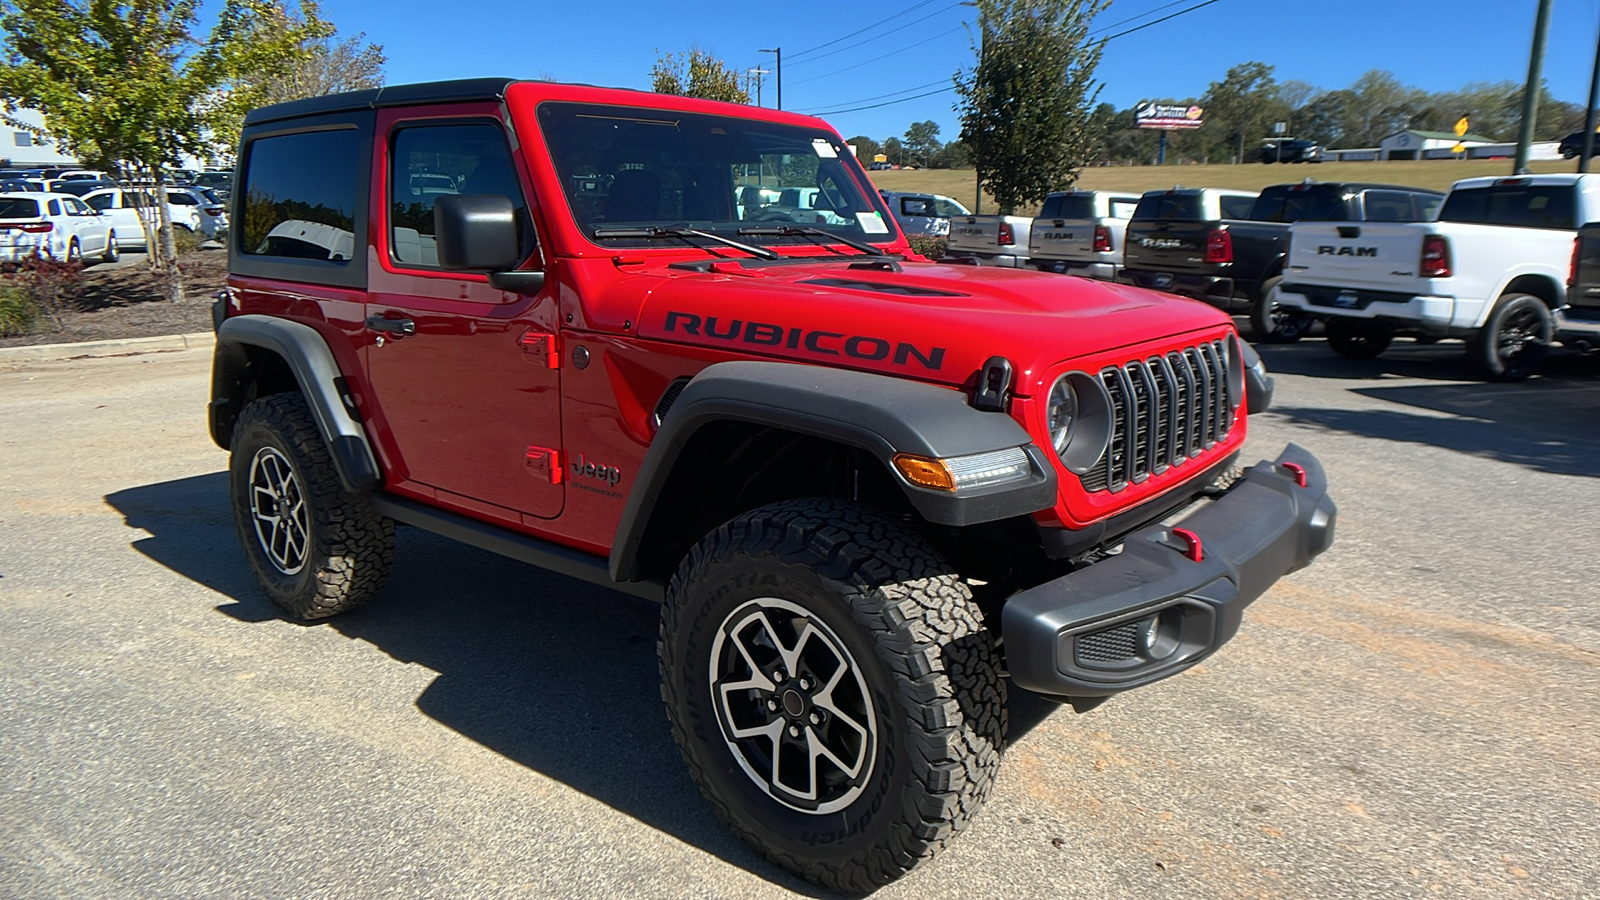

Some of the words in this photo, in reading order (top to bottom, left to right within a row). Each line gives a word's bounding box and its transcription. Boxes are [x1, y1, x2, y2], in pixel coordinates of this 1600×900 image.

[959, 228, 983, 236] RAM
[1043, 232, 1074, 240] RAM
[1141, 238, 1181, 247] RAM
[1318, 245, 1378, 257] RAM
[664, 311, 946, 371] RUBICON
[571, 454, 621, 487] Jeep
